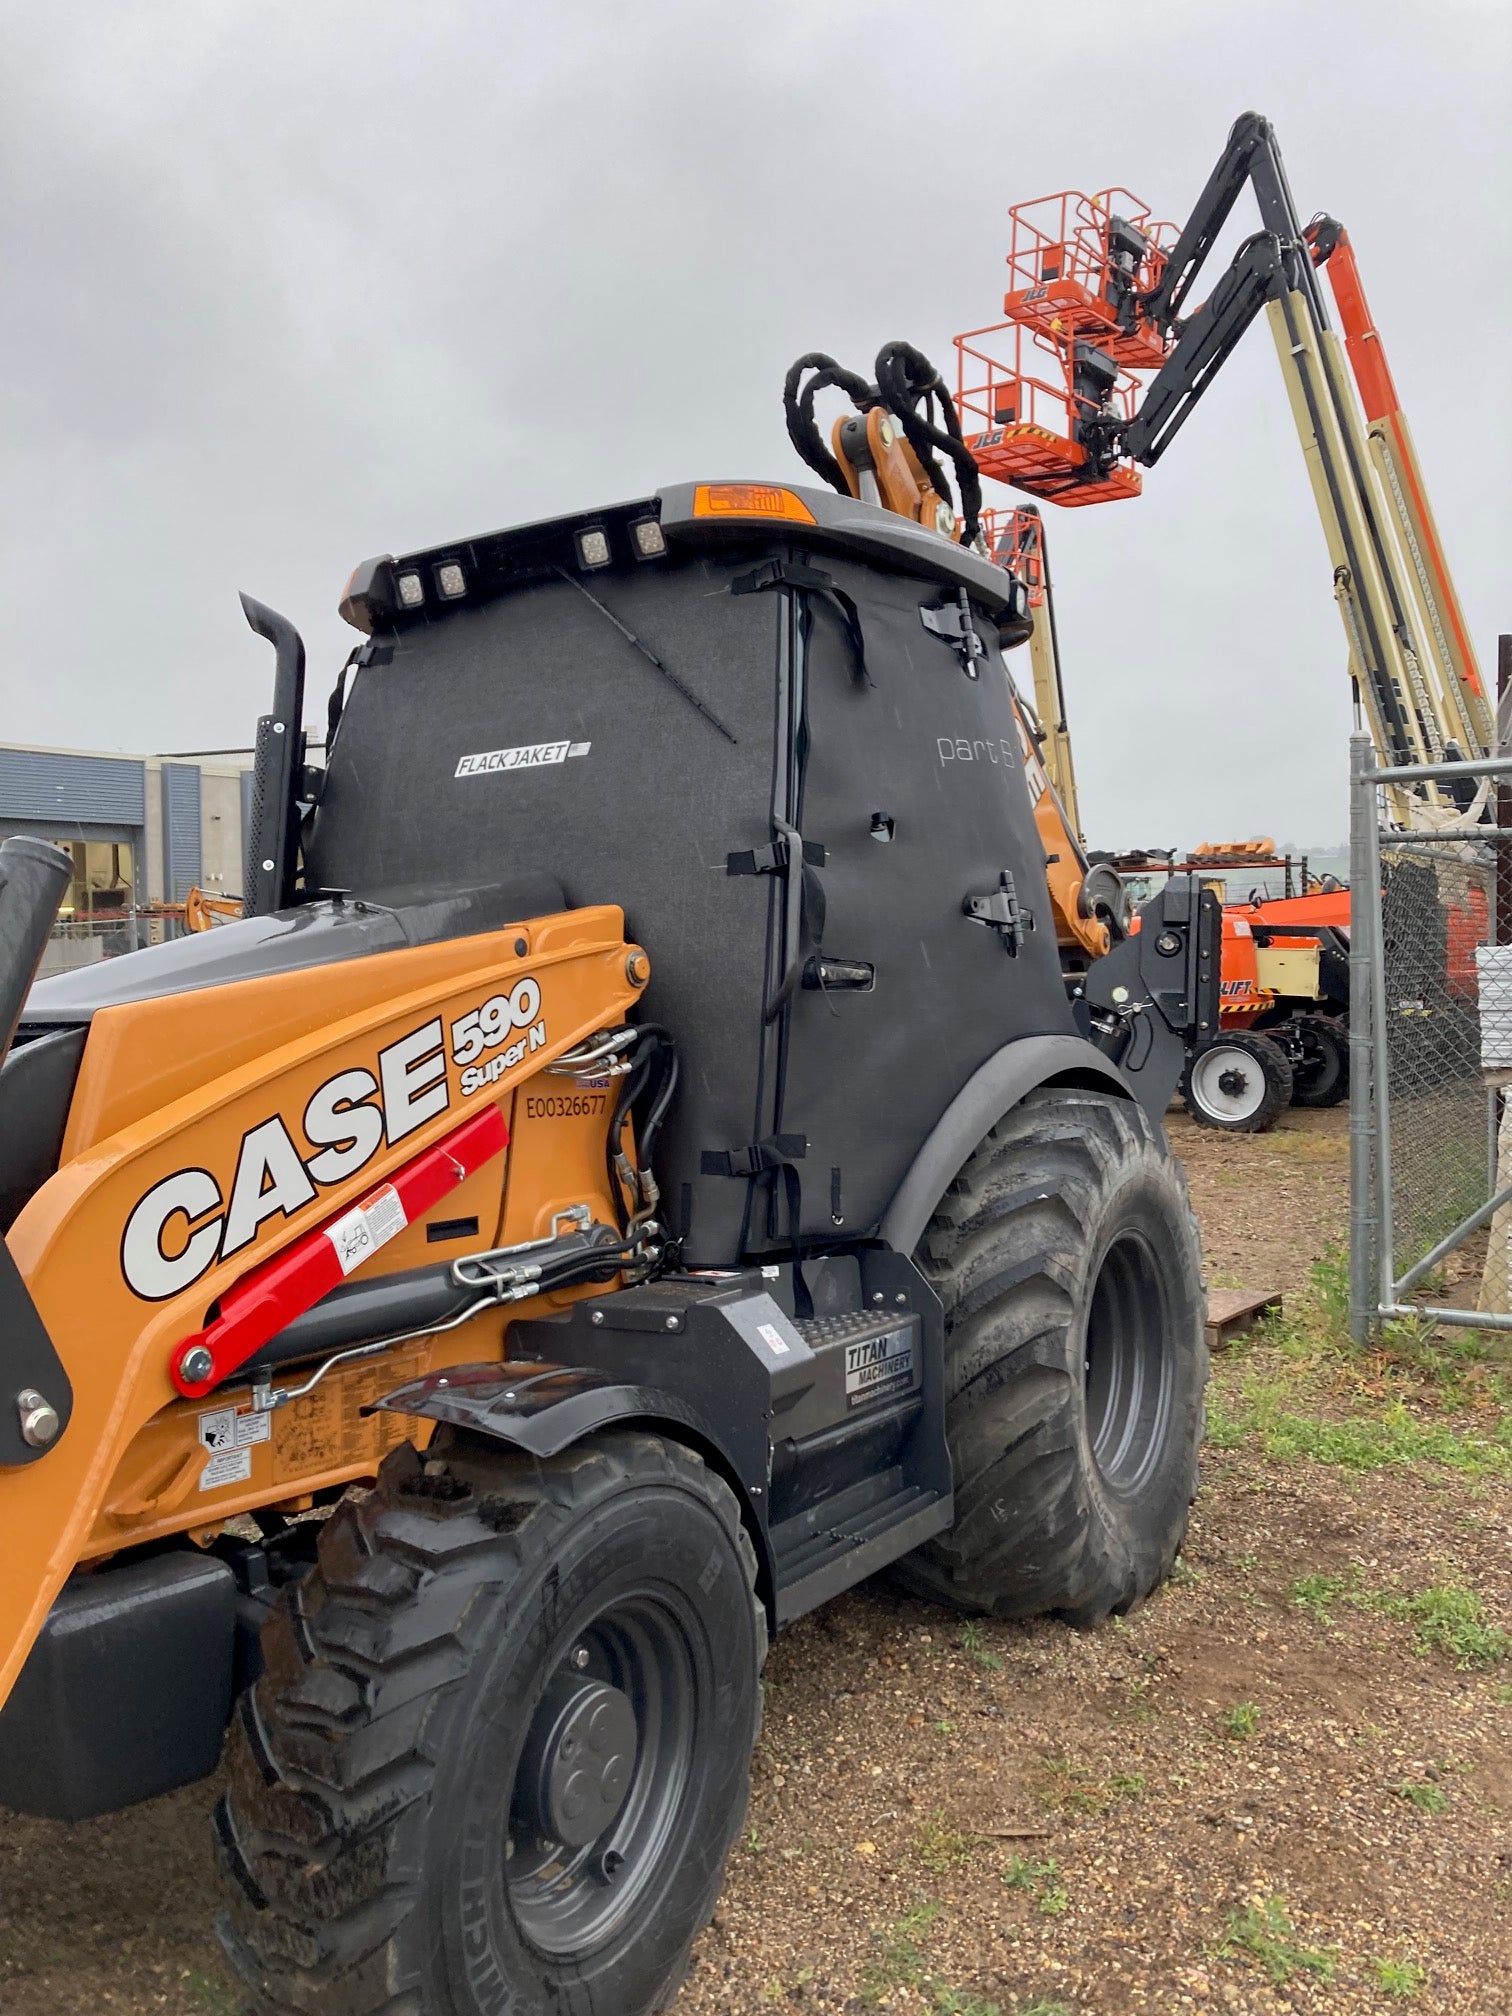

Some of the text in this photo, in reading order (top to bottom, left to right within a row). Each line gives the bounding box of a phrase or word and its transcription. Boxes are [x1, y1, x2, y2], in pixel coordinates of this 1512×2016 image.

[1020, 285, 1048, 303] JLG
[971, 430, 1004, 450] JLG
[458, 743, 567, 775] FLACK JAKET
[937, 738, 998, 767] part
[451, 976, 541, 1067] 590
[460, 1018, 547, 1096] Super N
[590, 1079, 611, 1088] USA
[526, 1094, 607, 1119] E00326677
[120, 1014, 450, 1302] CASE
[848, 1337, 888, 1370] TITAN
[858, 1354, 912, 1386] MACHINERY
